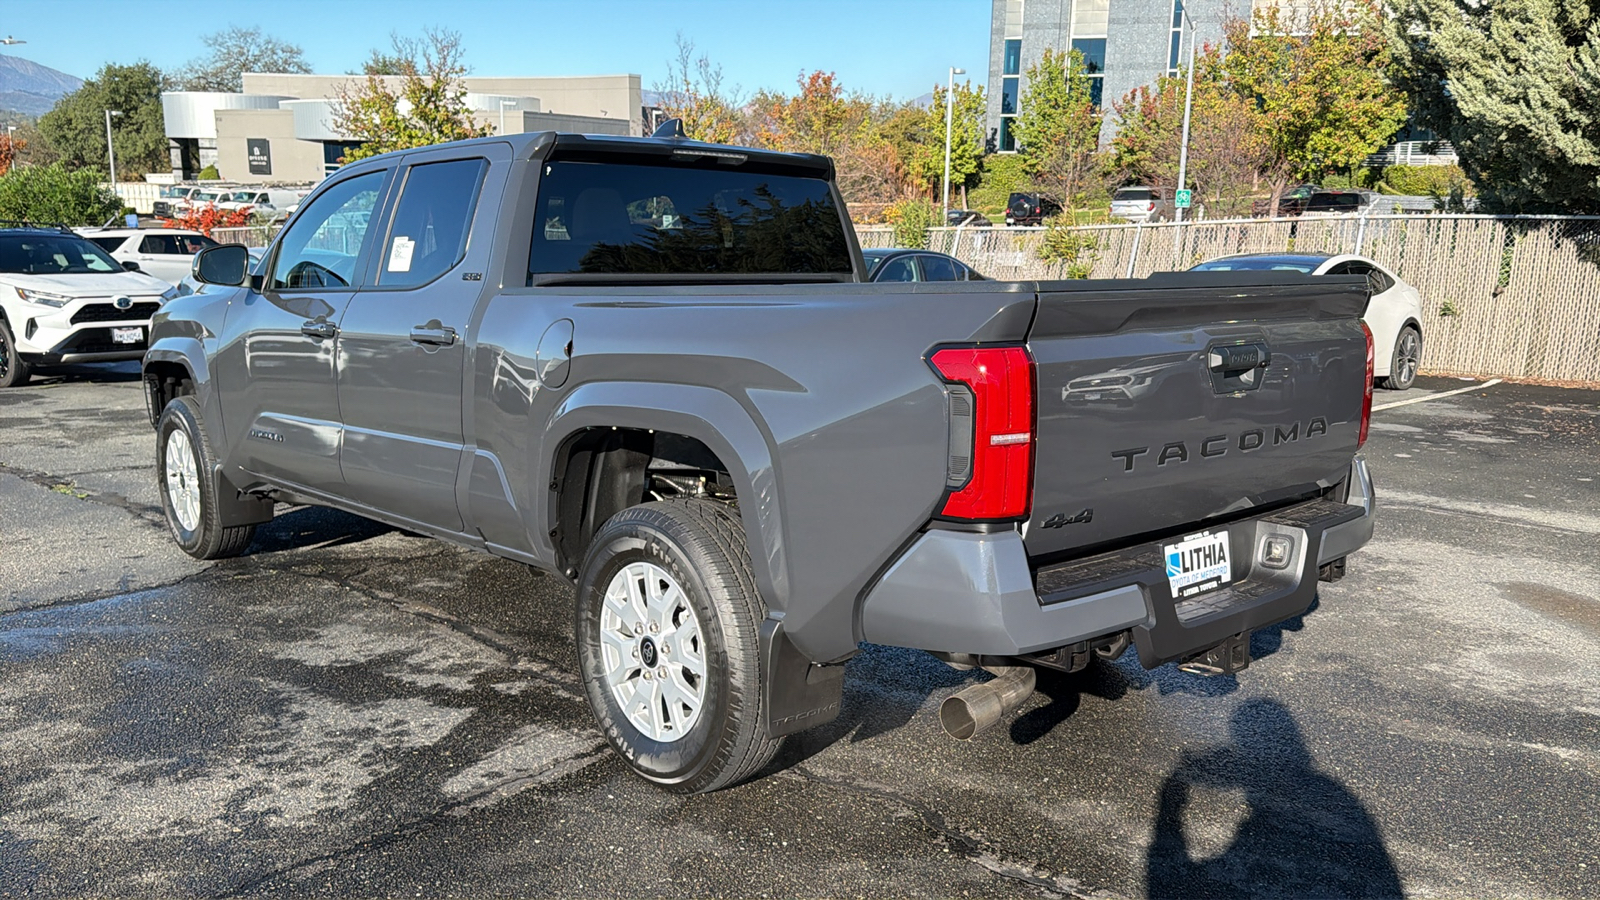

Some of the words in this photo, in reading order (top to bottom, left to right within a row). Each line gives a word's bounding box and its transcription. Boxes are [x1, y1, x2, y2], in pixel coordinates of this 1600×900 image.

[1111, 416, 1328, 472] TACOMA
[1181, 541, 1227, 573] LITHIA
[1171, 575, 1190, 589] OYOTA
[1201, 565, 1228, 579] MEDFORD
